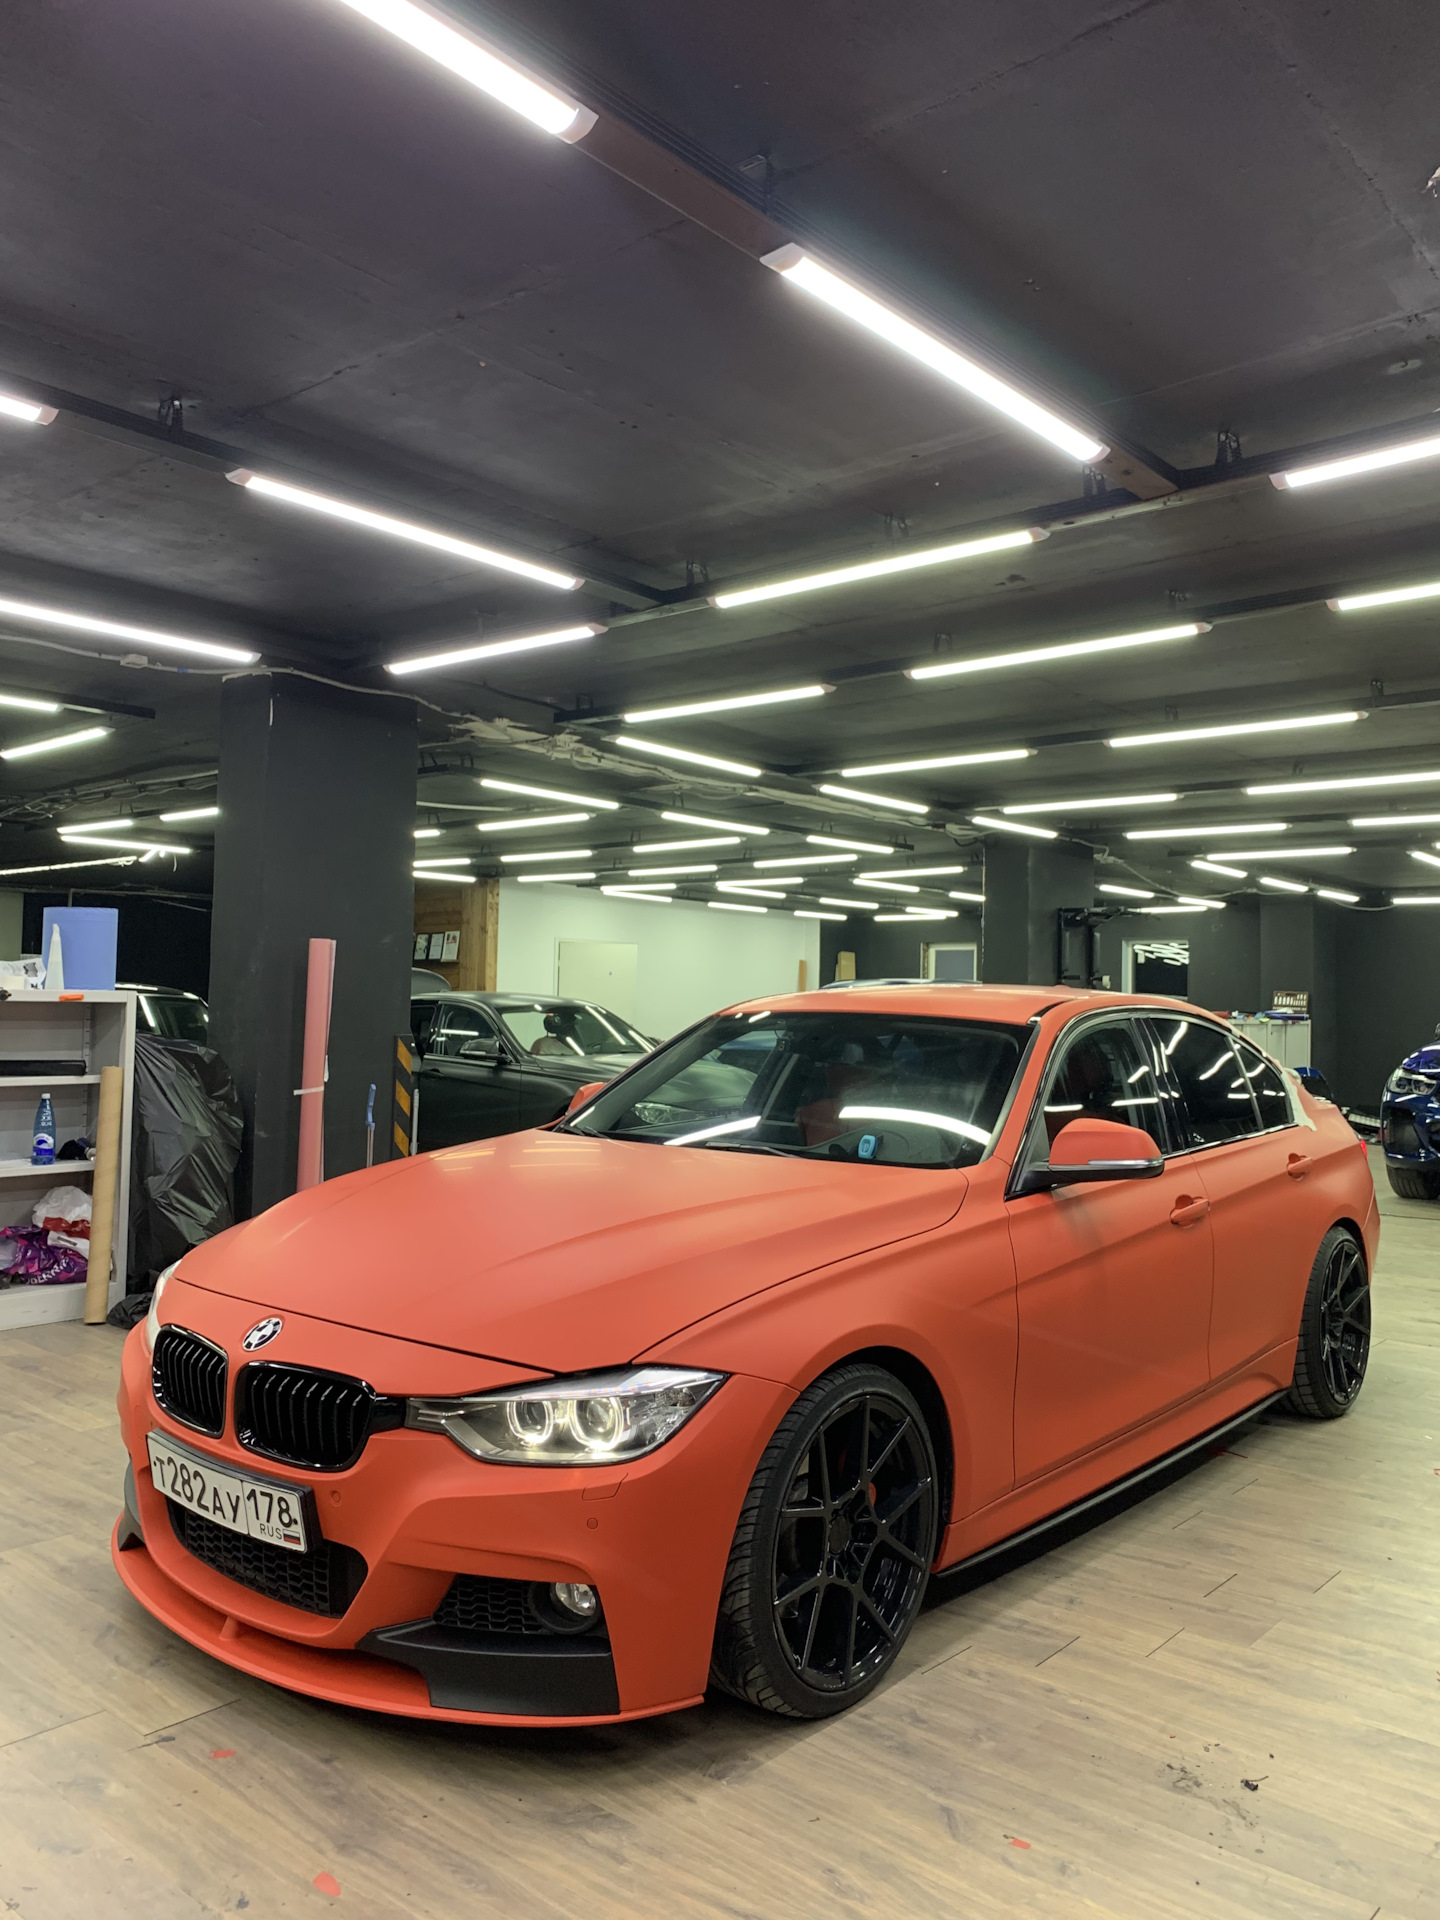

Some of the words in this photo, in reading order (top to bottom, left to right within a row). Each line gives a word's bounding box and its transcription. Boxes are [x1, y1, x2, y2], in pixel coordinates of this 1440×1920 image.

[155, 1456, 240, 1523] Т282АУ
[246, 1488, 293, 1528] 178
[259, 1523, 283, 1540] RUS
